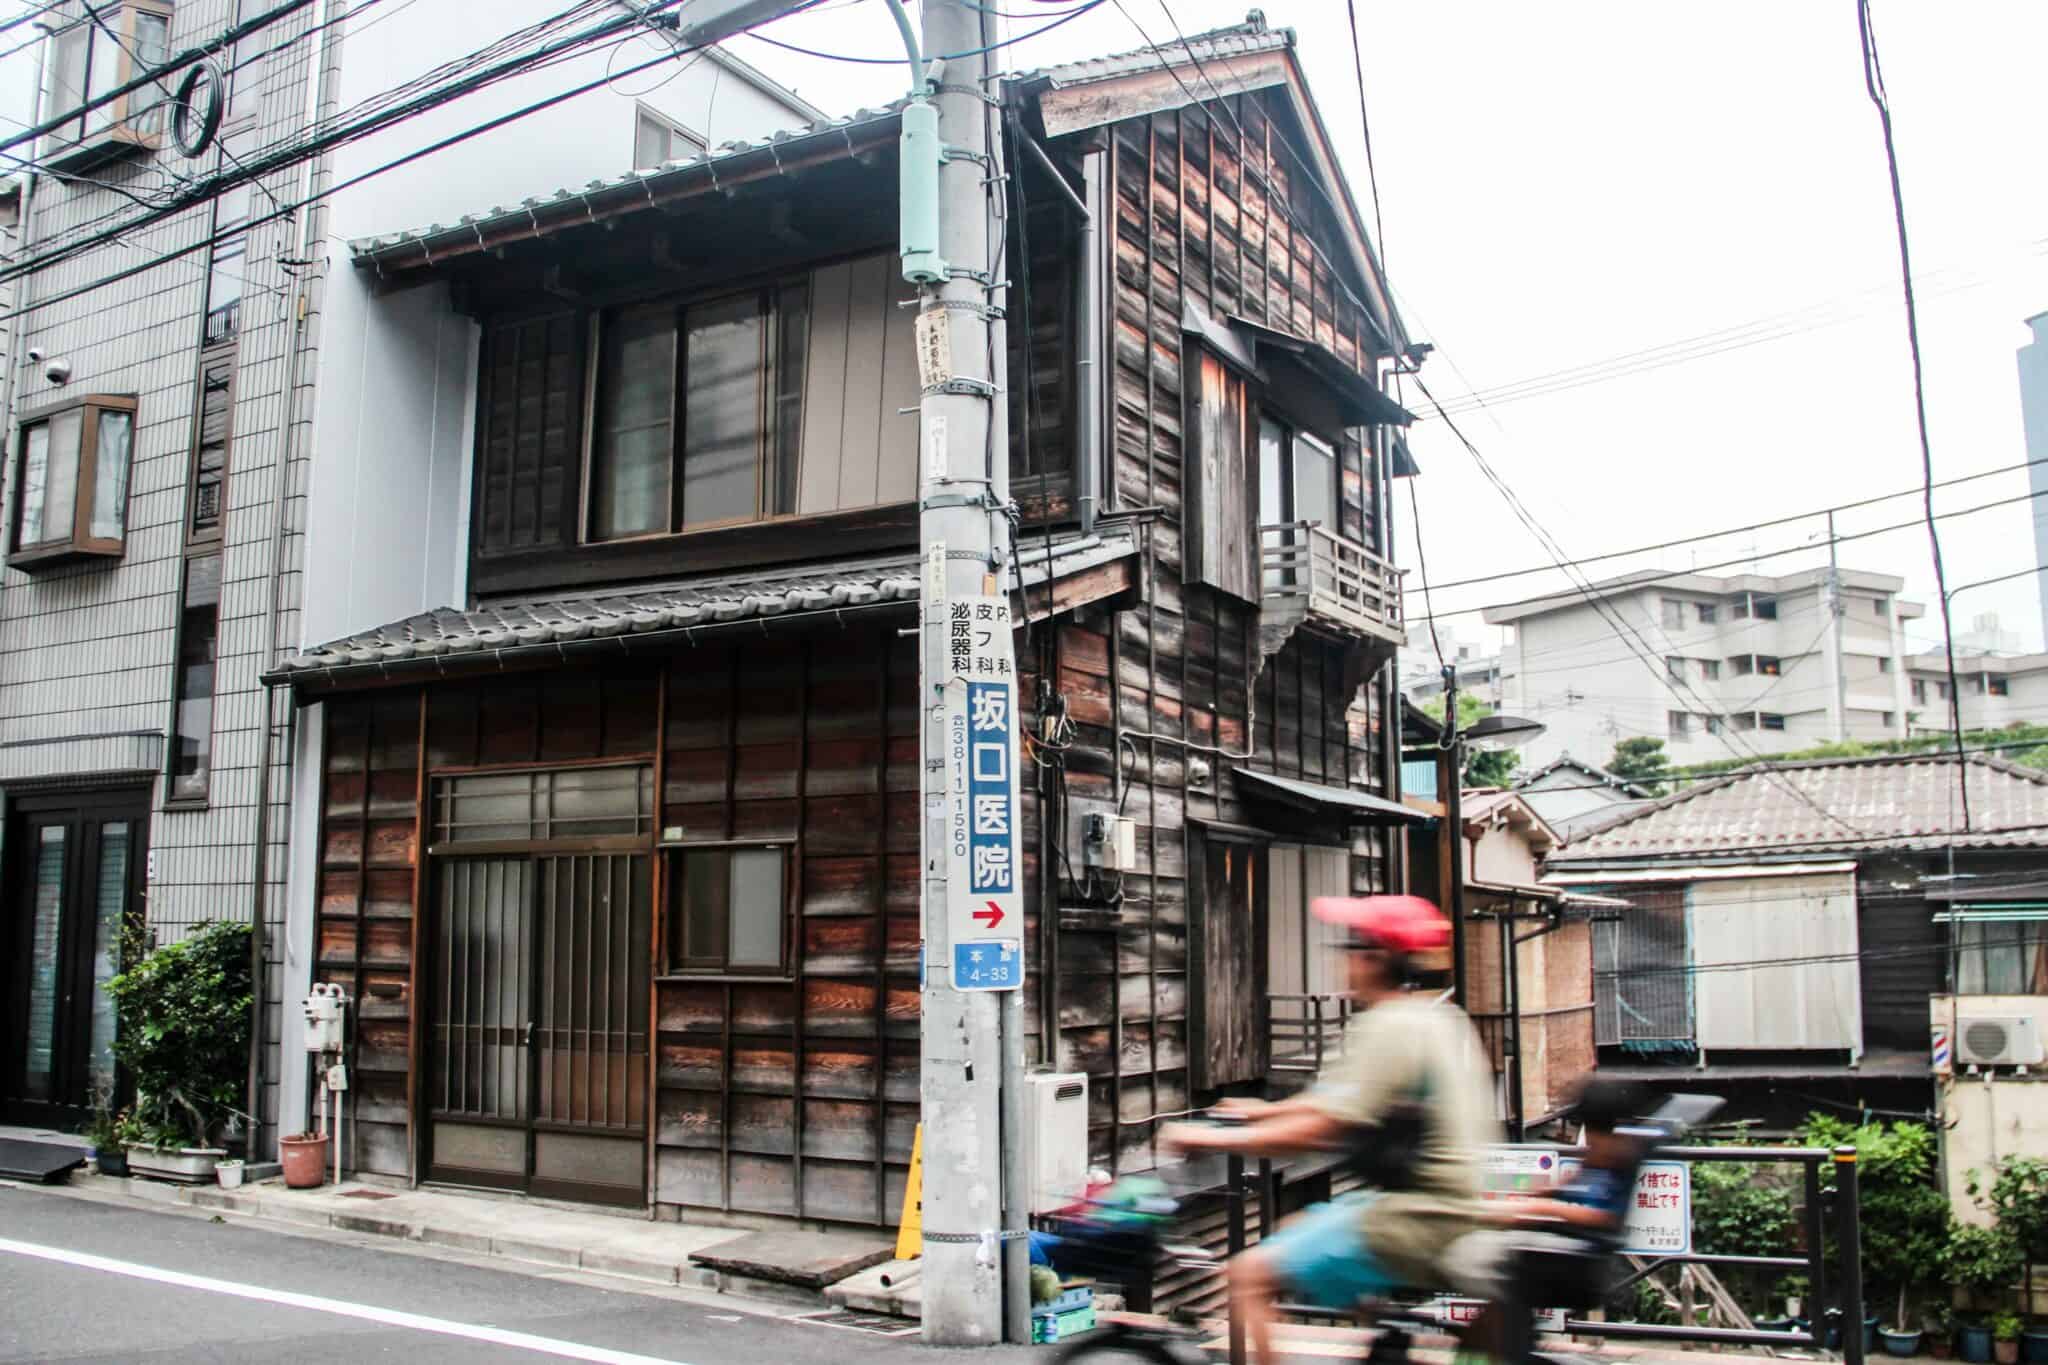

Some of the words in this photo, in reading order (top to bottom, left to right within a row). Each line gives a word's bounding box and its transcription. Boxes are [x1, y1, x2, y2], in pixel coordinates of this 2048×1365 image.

[952, 602, 971, 673] 泌尿器科
[976, 604, 993, 674] 皮フ科
[972, 687, 1009, 889] 坂口医院
[1637, 1193, 1680, 1208] 禁止です
